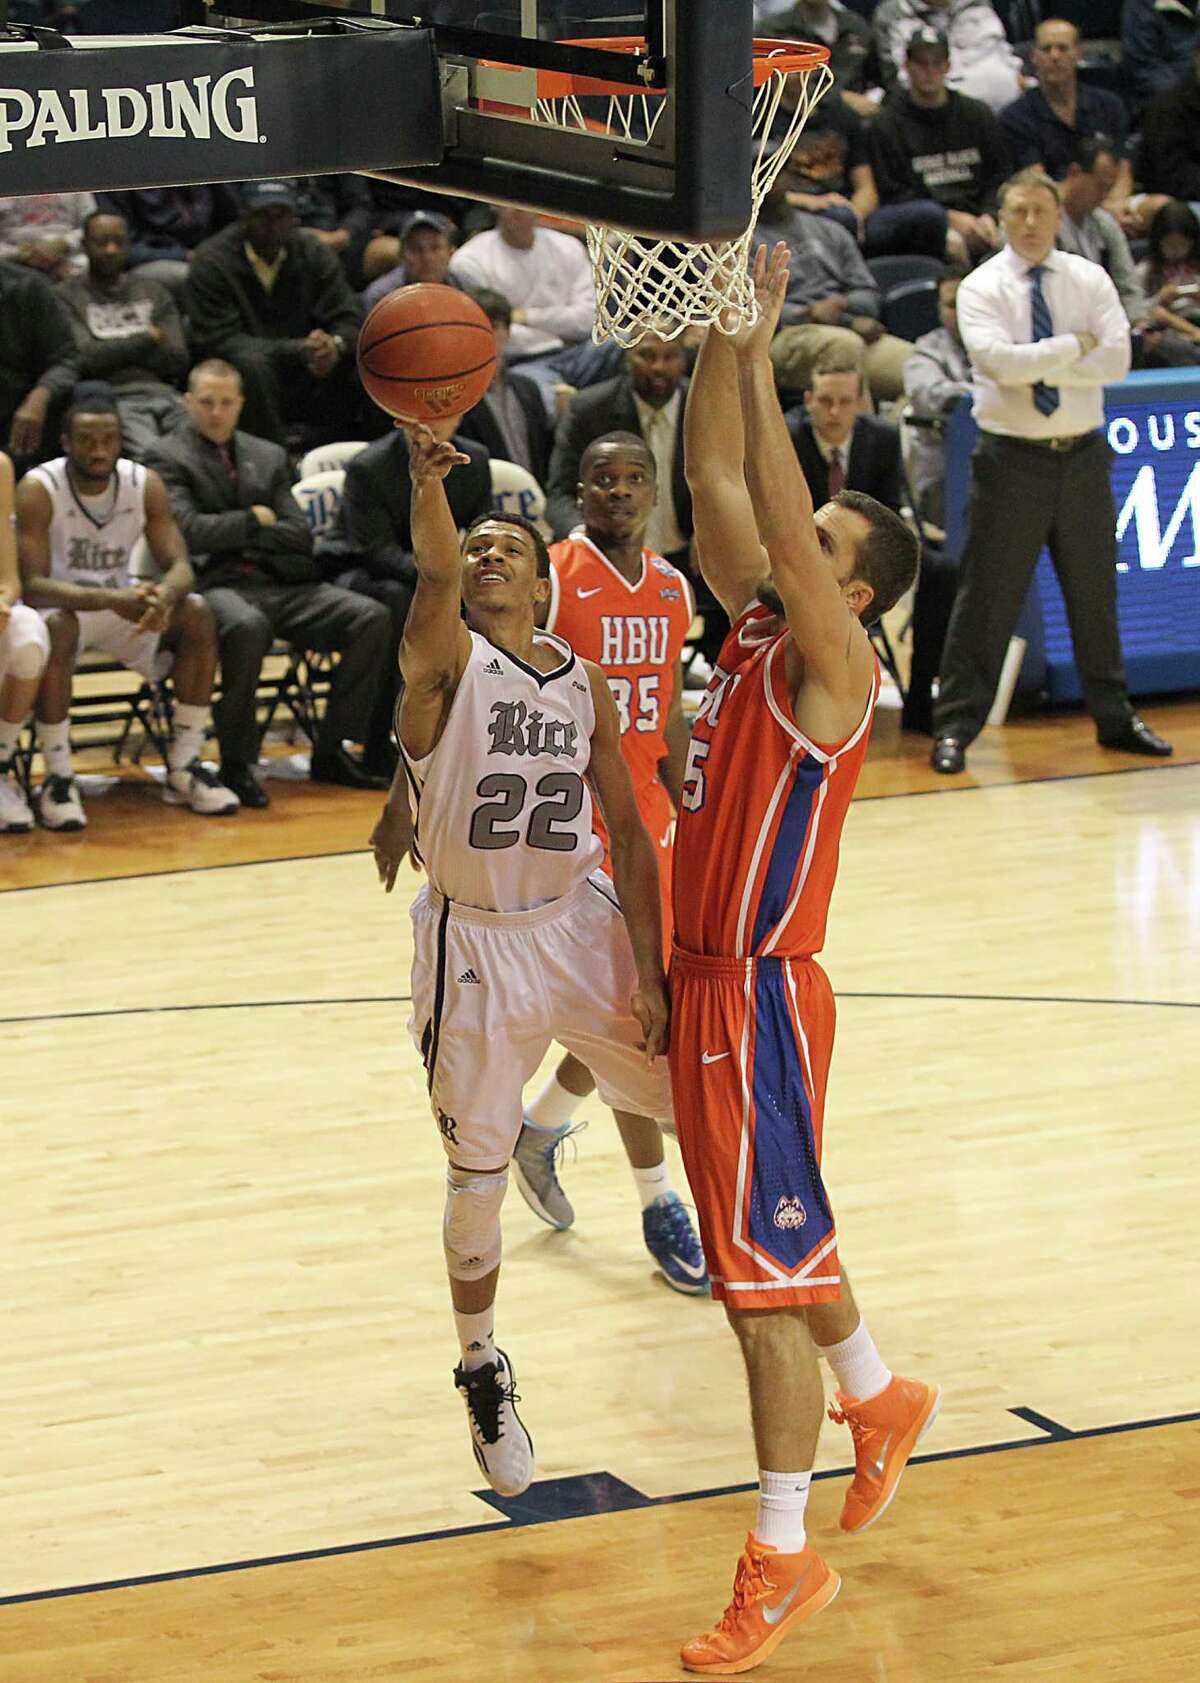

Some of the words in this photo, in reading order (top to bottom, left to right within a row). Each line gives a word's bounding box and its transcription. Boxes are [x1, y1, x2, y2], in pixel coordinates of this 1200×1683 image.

[0, 66, 259, 153] PALDING
[600, 616, 669, 665] HBU
[487, 700, 579, 758] Rice
[607, 674, 660, 735] 35
[469, 772, 584, 851] 22
